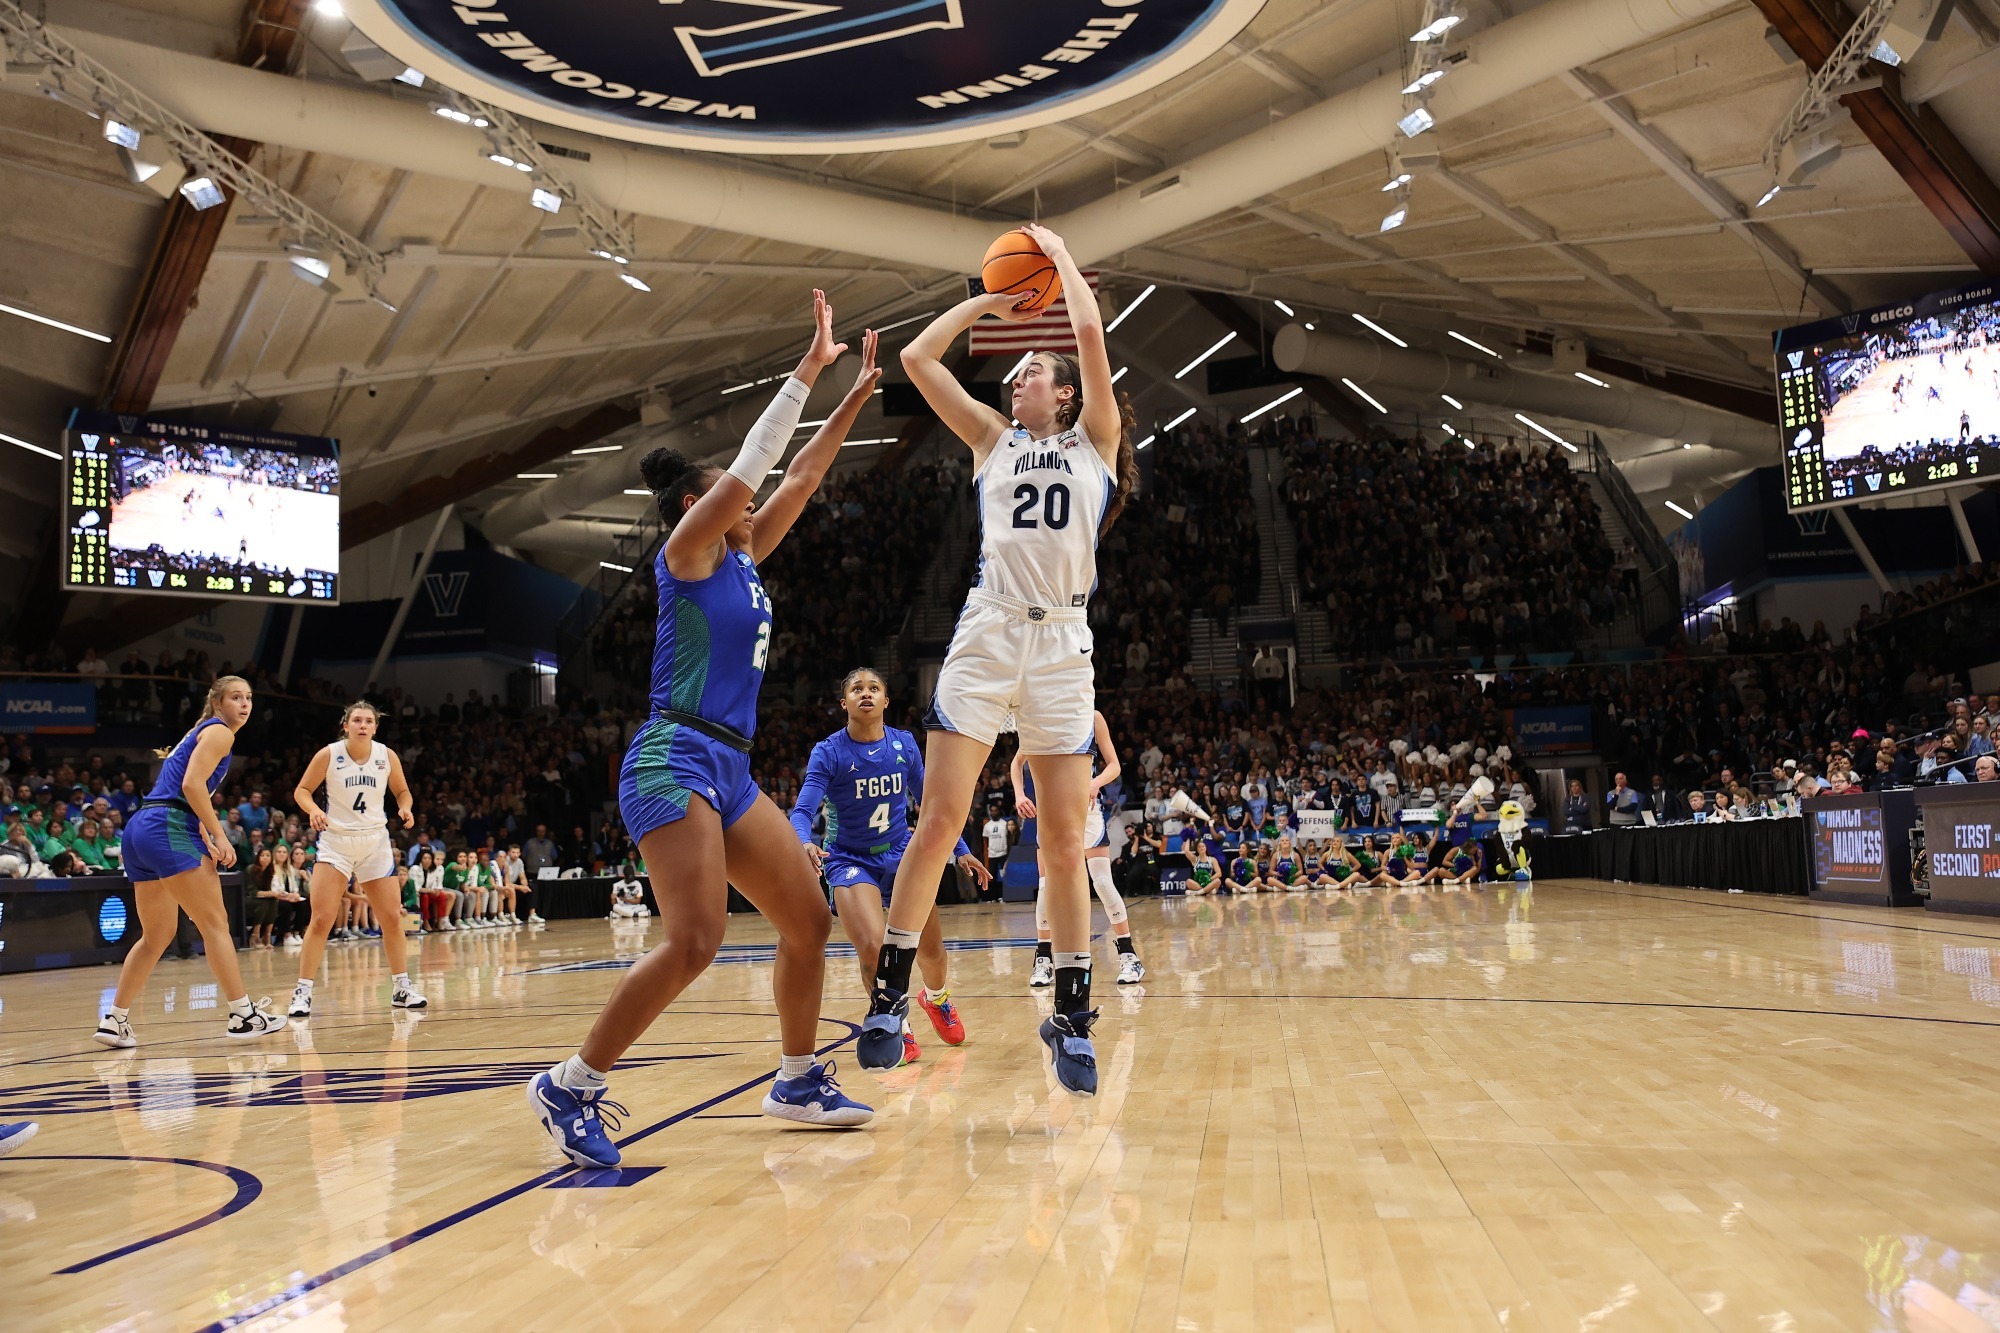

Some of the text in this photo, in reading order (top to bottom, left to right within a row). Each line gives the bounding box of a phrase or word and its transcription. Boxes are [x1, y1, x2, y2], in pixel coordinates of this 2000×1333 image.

[916, 12, 1140, 109] THE FINN
[477, 31, 757, 120] WELCOME
[1939, 287, 1992, 307] VIDEO BOARD
[1870, 305, 1914, 324] GRECO
[1888, 471, 1906, 486] 54
[1927, 462, 1958, 480] 2:28
[1970, 463, 1978, 474] 3
[1012, 483, 1070, 530] 20
[170, 573, 188, 588] 54
[206, 575, 234, 590] 2:28
[243, 583, 250, 593] 3
[423, 571, 470, 617] V
[345, 775, 376, 788] VILLANOVA
[855, 772, 902, 799] FGCU
[352, 792, 367, 814] 4
[868, 802, 890, 835] 4
[1298, 817, 1334, 825] DEFENSE
[1826, 808, 1861, 828] MARCH
[1832, 830, 1882, 864] MADNESS
[1954, 824, 1991, 849] FIRST
[1933, 853, 1979, 877] SECOND
[1160, 881, 1186, 891] BLUE
